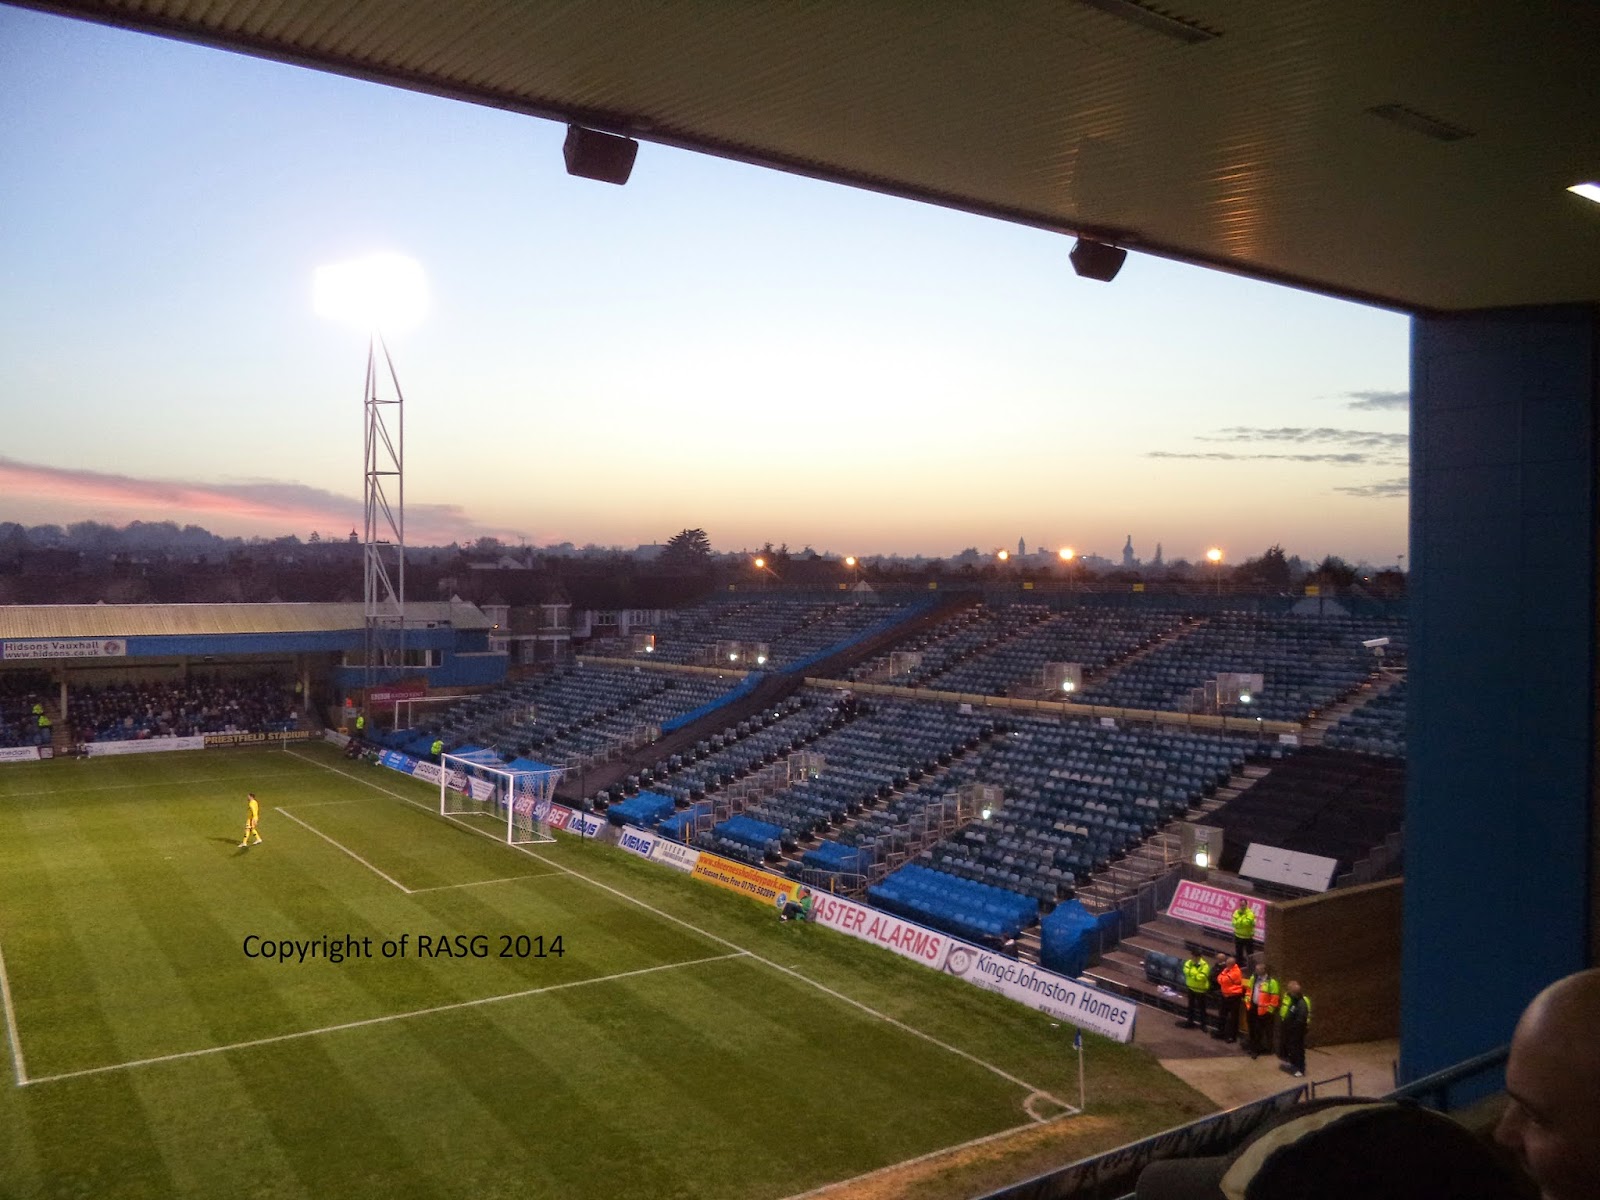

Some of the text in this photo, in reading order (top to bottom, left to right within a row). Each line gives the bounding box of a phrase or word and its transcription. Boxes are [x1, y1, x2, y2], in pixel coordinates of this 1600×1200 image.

[5, 641, 99, 651] Hidsons Vauxhall
[5, 649, 99, 658] www.hidsons.co.uk
[205, 733, 265, 744] PRIESTFIELD
[268, 731, 309, 740] STADIUM
[548, 808, 568, 827] BET
[621, 833, 651, 854] MEMS
[702, 867, 719, 880] Season
[719, 872, 730, 883] Fees
[729, 876, 741, 887] Free
[1180, 885, 1239, 910] ABBIE'S
[866, 917, 941, 960] ALARMS
[976, 953, 1127, 1025] King&Johnston Homes
